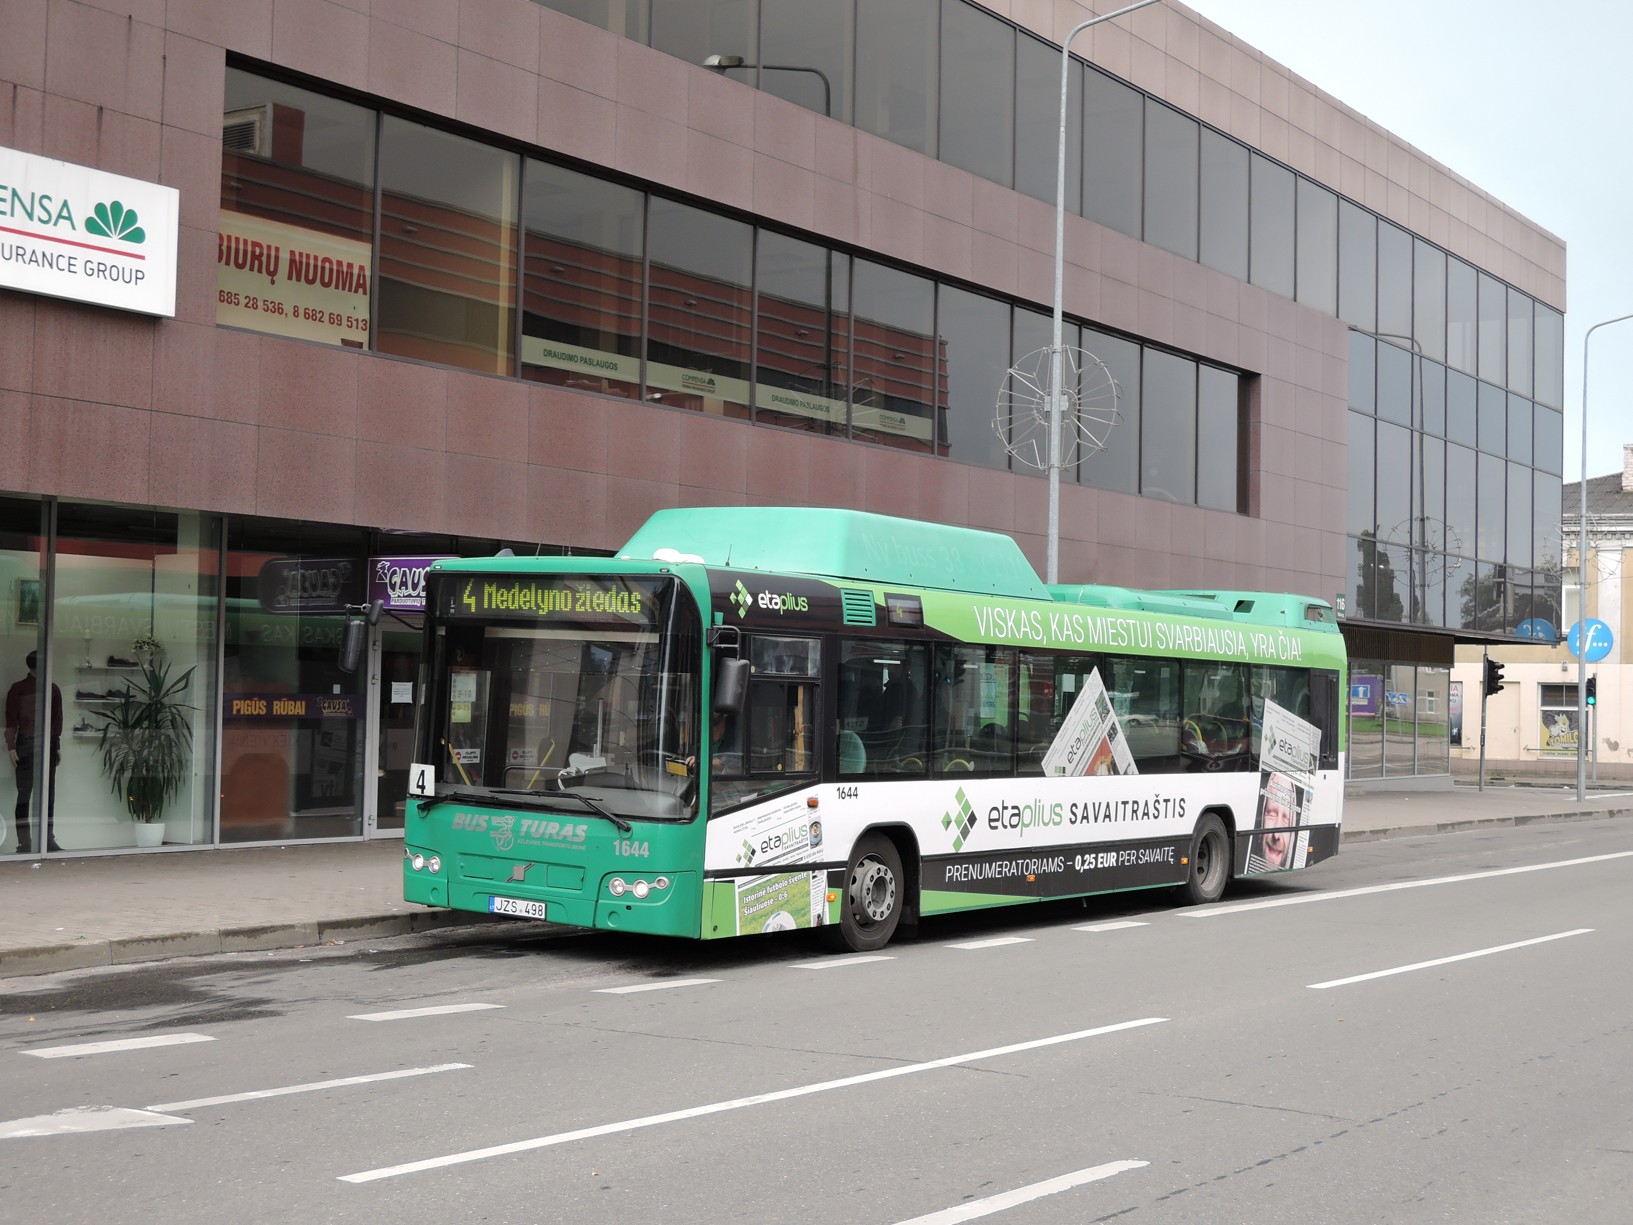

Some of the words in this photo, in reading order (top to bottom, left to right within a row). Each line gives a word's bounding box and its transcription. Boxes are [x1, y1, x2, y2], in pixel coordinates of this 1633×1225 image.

[0, 184, 77, 231] ENSA
[1, 242, 78, 274] URANCE
[84, 259, 146, 286] GROUP
[218, 232, 280, 286] BIURŲ
[287, 249, 368, 296] NUOMA
[218, 289, 240, 307] 685
[244, 295, 259, 311] 28
[262, 299, 288, 319] 536,
[292, 305, 300, 319] 8
[303, 307, 325, 323] 682
[328, 312, 343, 327] 69
[346, 316, 368, 332] 513
[543, 348, 579, 363] DRAUDIMO
[579, 356, 618, 371] PASLAUGOS
[463, 578, 476, 613] 4
[483, 582, 571, 614] Medelyno
[575, 584, 641, 613] žiedas
[757, 590, 808, 615] etaplius
[974, 605, 1047, 645] VISKAS,
[1051, 612, 1084, 643] KAS
[1089, 616, 1151, 648] MIESTUI
[1156, 622, 1249, 660] SVARBIAUSIA,
[1249, 632, 1276, 658] YRA
[1277, 630, 1302, 661] ČIA!
[232, 697, 267, 715] PIGŪS
[272, 698, 306, 715] RŪBAI
[416, 769, 426, 794] 4
[836, 786, 859, 800] 1644
[452, 813, 489, 832] BUS
[519, 819, 588, 843] TURAS
[988, 798, 1063, 838] etaplius
[1069, 793, 1186, 825] SAVAITRAŠTIS
[612, 839, 649, 858] 1644
[760, 824, 809, 854] etaplius
[945, 856, 1064, 883] PRENUMERATORIAMS
[1074, 854, 1096, 874] 0,25
[1097, 852, 1117, 869] EUR
[1118, 850, 1137, 866] PER
[1138, 846, 1175, 864] SAVAITĘ
[495, 899, 518, 913] JZS
[524, 902, 544, 917] 498
